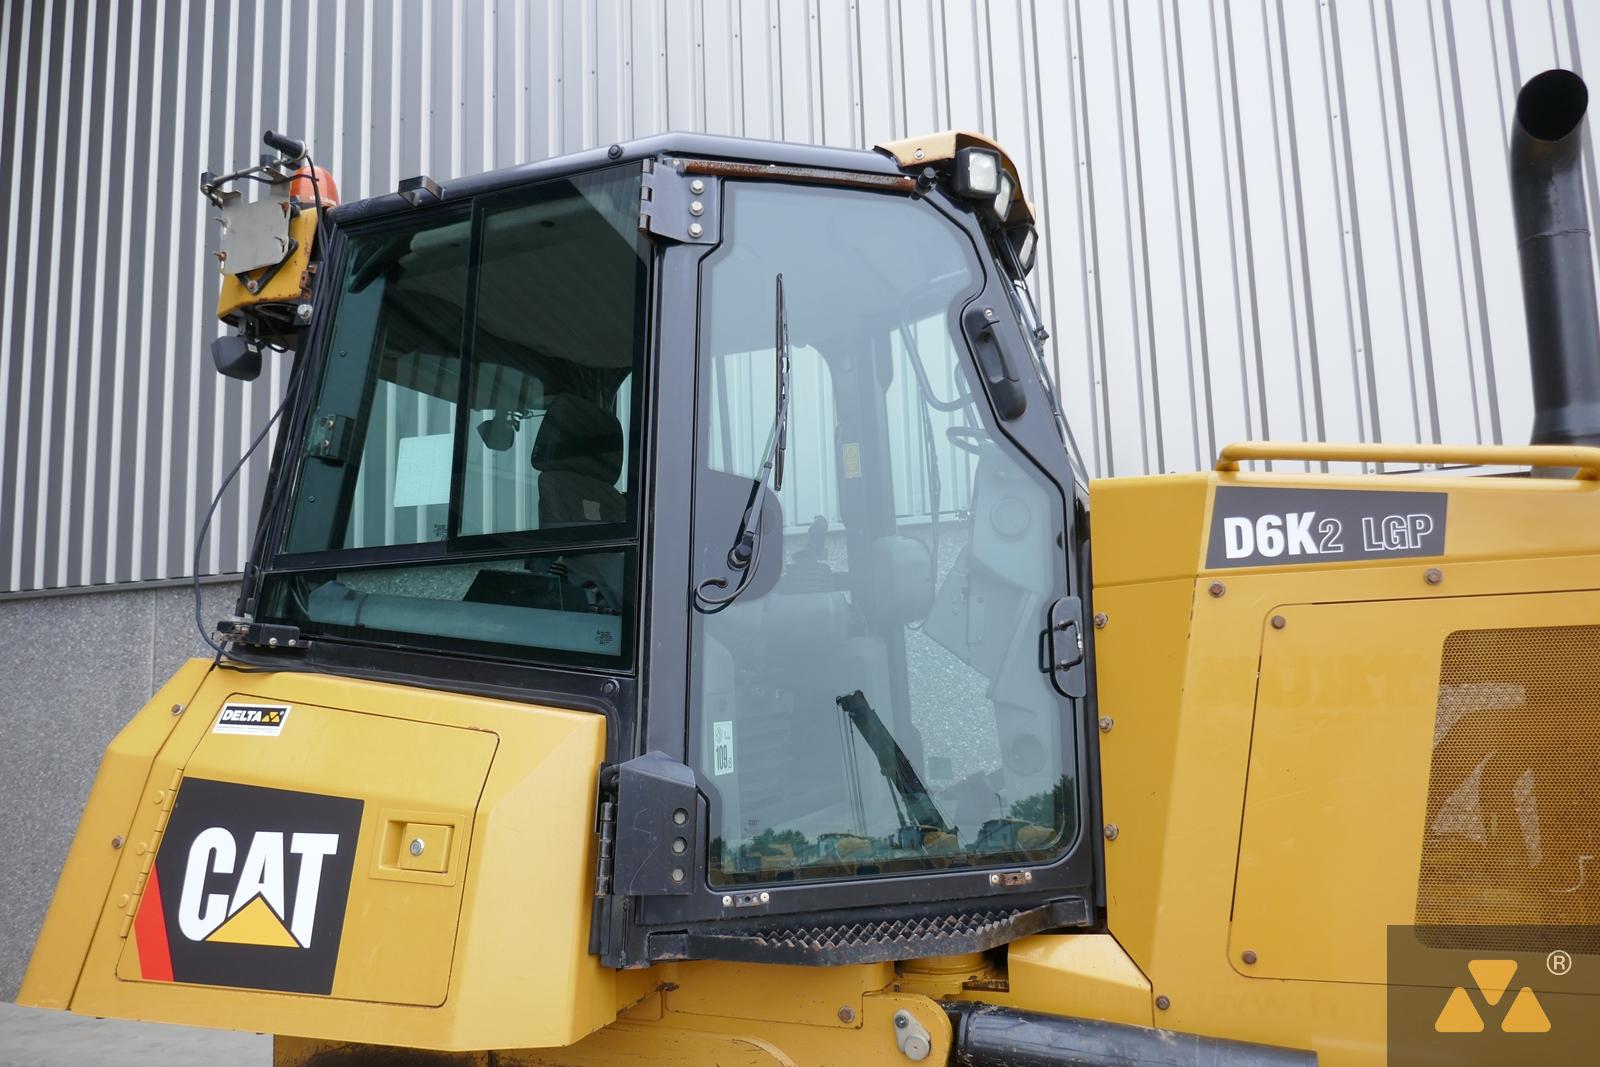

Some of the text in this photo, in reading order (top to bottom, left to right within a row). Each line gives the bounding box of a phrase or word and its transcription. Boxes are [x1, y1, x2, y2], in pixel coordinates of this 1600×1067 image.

[1362, 513, 1434, 551] LGP
[221, 709, 262, 722] DELTA
[715, 744, 728, 770] 109
[178, 827, 339, 949] CAT
